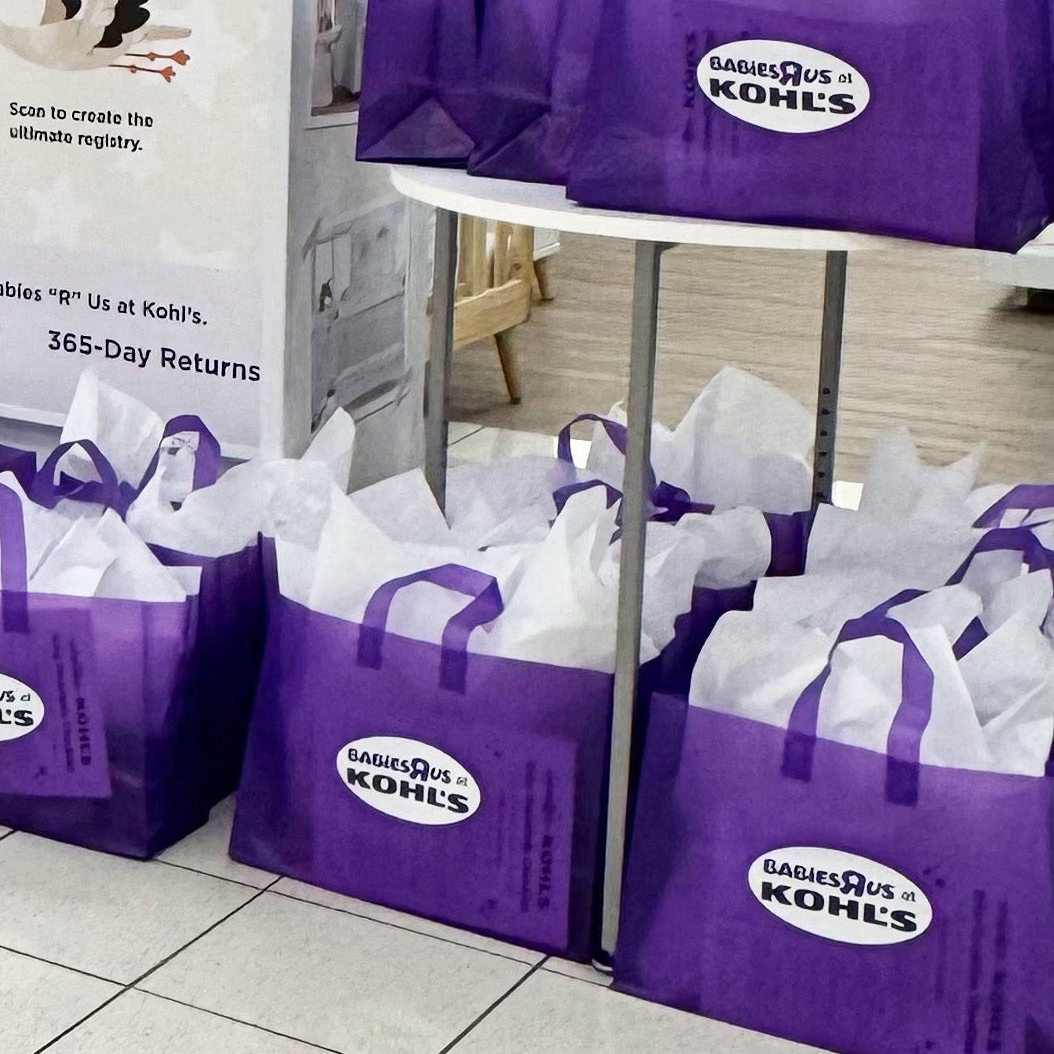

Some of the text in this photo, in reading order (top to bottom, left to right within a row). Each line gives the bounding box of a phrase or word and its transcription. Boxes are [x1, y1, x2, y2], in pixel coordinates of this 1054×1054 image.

[9, 102, 154, 128] Scan to create the
[709, 78, 856, 115] KOHL'S
[9, 125, 73, 144] ultimate
[88, 293, 111, 312] Us
[117, 299, 136, 316] at
[48, 329, 261, 382] 365-Day Returns
[347, 767, 469, 814] KOHL'S
[761, 881, 918, 933] KOHL'S
